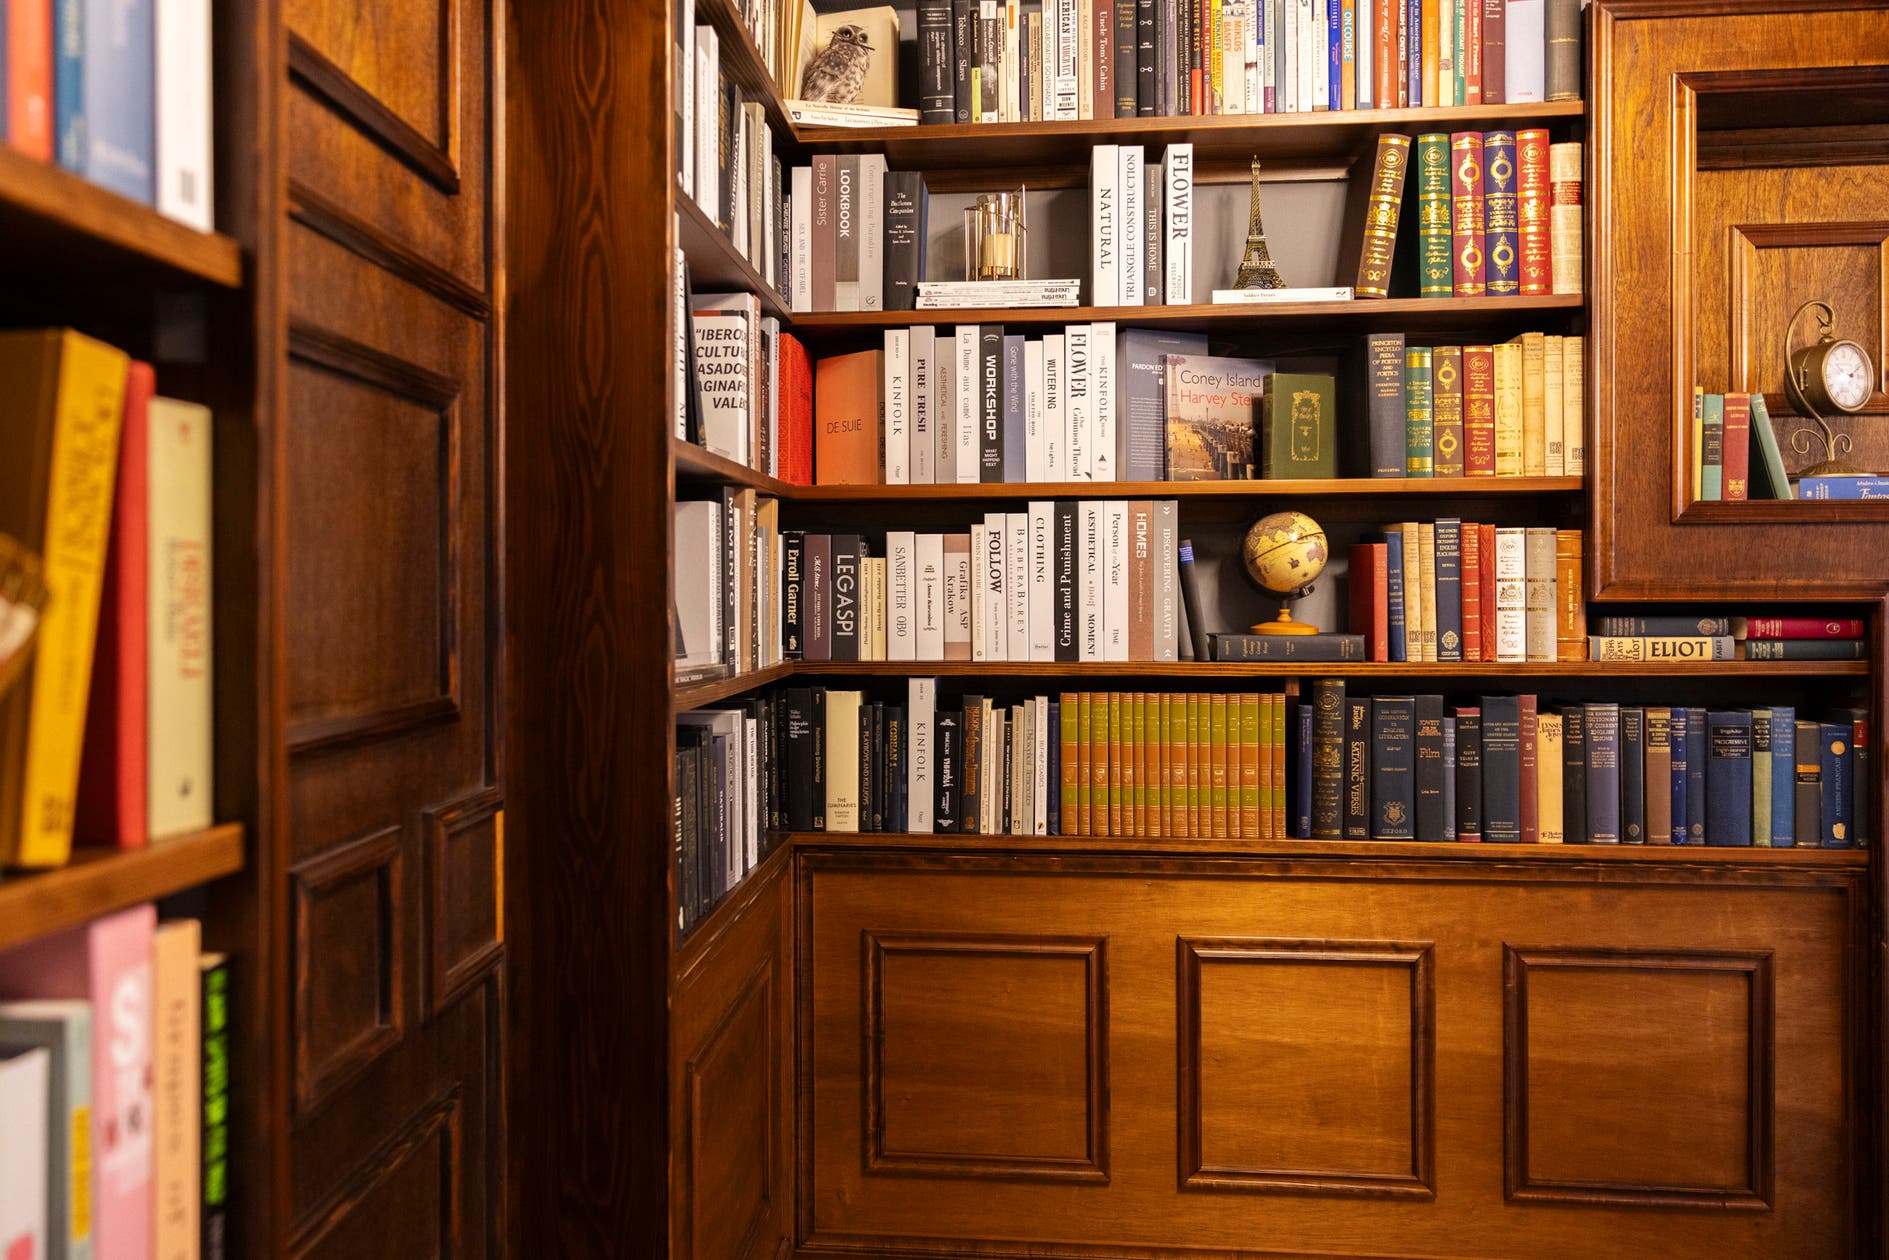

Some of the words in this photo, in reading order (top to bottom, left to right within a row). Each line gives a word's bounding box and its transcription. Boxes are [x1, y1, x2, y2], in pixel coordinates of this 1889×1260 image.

[958, 15, 966, 45] Tobacco
[1062, 0, 1070, 34] ERICAN
[1099, 11, 1108, 36] Uncle
[1344, 12, 1352, 25] ON
[1062, 37, 1070, 76] DEMOCRACY
[1099, 38, 1108, 64] Tom's
[1344, 26, 1352, 58] COURSE
[958, 59, 966, 80] Slaves
[1099, 66, 1108, 91] Cabin
[730, 132, 739, 220] WONDERFUL
[817, 163, 827, 194] Carrie
[817, 197, 827, 225] Sister
[840, 170, 850, 237] LOOKBOOK
[1126, 154, 1135, 241] CONSTRUCTION
[1172, 154, 1189, 240] FLOWER
[1100, 188, 1111, 269] NATURAL
[1148, 208, 1156, 229] THIS
[1148, 232, 1156, 241] IS
[1126, 243, 1135, 300] TRIANGLE
[1148, 243, 1156, 271] HOME
[963, 333, 972, 344] La
[963, 349, 972, 371] Dame
[1010, 346, 1018, 364] Gone
[1071, 333, 1086, 398] FLOWER
[917, 359, 925, 389] PURE
[963, 376, 972, 392] aux
[1010, 364, 1018, 381] with
[1010, 382, 1018, 394] the
[1048, 359, 1056, 409] WUTERING
[1181, 370, 1222, 389] Coney
[1227, 373, 1261, 387] Island
[893, 376, 902, 435] KINFOLK
[917, 395, 925, 432] FRESH
[986, 355, 996, 440] WORKSHOP
[1010, 395, 1018, 412] Wind
[1181, 390, 1227, 408] Harvey
[1231, 392, 1253, 406] Ste
[827, 422, 839, 434] DE
[842, 419, 862, 432] SUIE
[963, 425, 972, 446] lias
[1072, 408, 1081, 445] Common
[1072, 447, 1081, 476] Thread
[1088, 509, 1096, 574] AESTHETICAL
[1112, 513, 1121, 547] Person
[1136, 513, 1146, 558] HOMES
[788, 549, 799, 581] Erroll
[989, 531, 1002, 594] FOLLOW
[1036, 517, 1045, 583] CLOTHING
[1060, 514, 1072, 585] Punishment
[1163, 528, 1171, 592] IDSCOVERING
[895, 547, 907, 609] SANBETTER
[959, 561, 968, 600] Grafika
[1112, 563, 1121, 586] Year
[788, 584, 799, 624] Garner
[837, 555, 854, 636] LEGASPI
[947, 575, 956, 614] Krakow
[1060, 588, 1072, 609] and
[895, 616, 907, 637] OBO
[959, 609, 968, 629] ASP
[1060, 612, 1072, 646] Crime
[1088, 613, 1096, 656] MOMENT
[1163, 598, 1171, 640] GRAVITY
[1651, 642, 1707, 657] ELIOT
[889, 720, 898, 760] KOREAN
[916, 722, 926, 782] KINFOLK
[1419, 748, 1440, 758] Film
[1351, 742, 1360, 781] SATANIC
[1351, 784, 1360, 815] VERSES
